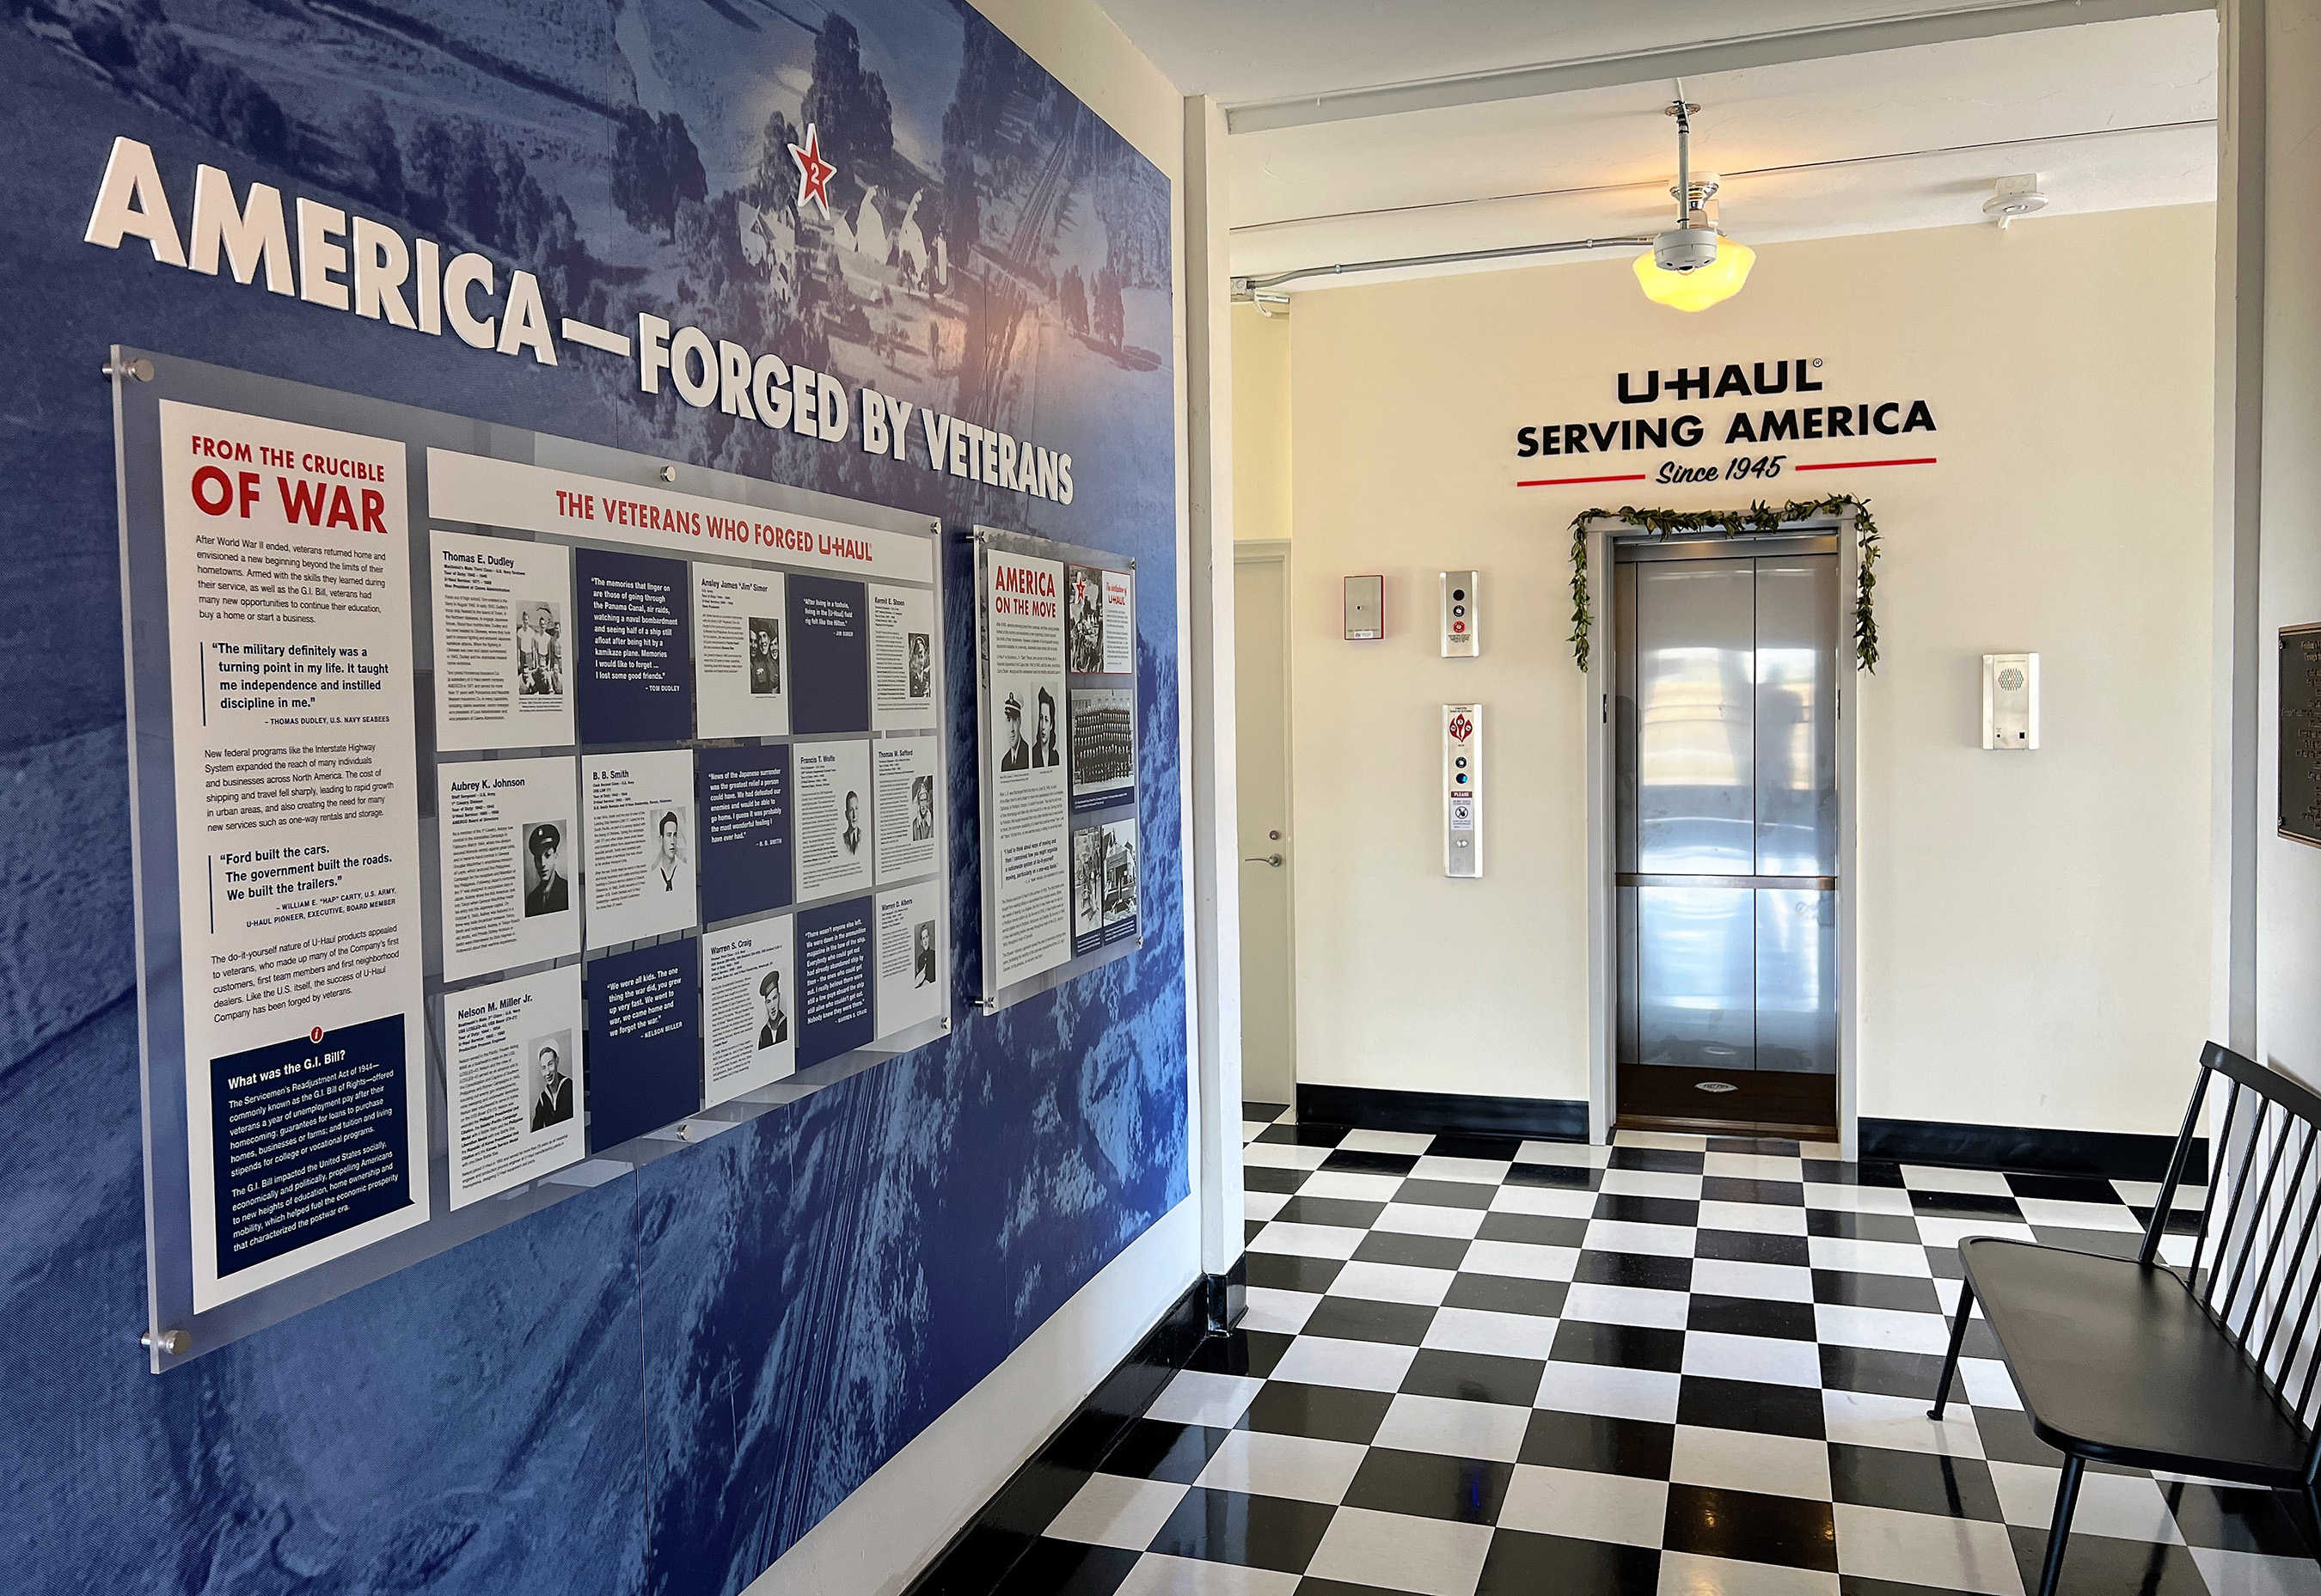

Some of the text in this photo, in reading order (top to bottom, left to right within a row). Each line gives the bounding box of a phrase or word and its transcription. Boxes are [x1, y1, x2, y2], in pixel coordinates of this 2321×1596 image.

[810, 162, 820, 186] 2
[1516, 400, 1937, 457] SERVING AMERICA
[192, 435, 385, 483] FROM THE CRUCIBLE
[862, 387, 913, 462] BY
[921, 407, 1074, 505] VETERANS
[1656, 456, 1786, 484] Since 1945
[191, 465, 389, 535] OF WAR
[555, 490, 594, 521] THE
[602, 498, 701, 536] VETERANS
[706, 515, 750, 543] WHO
[754, 523, 813, 553] FORGED
[195, 535, 386, 561] After World War II ended, veterans returned home and
[995, 565, 1056, 598] AMERICA
[1013, 598, 1029, 616] THE
[1032, 600, 1056, 619] MOVE
[243, 643, 285, 657] military
[288, 644, 336, 658] definitely
[339, 648, 358, 657] was
[218, 661, 389, 676] turning point in my life. It taught
[219, 679, 381, 693] me independence and instilled
[220, 697, 275, 711] discipline
[278, 696, 288, 708] in
[205, 743, 377, 758] New federal programs like the Interstate Highway
[254, 848, 280, 861] built
[283, 847, 301, 859] the
[303, 846, 330, 856] cars.
[225, 853, 392, 883] The government built the roads.
[226, 889, 245, 902] We
[248, 884, 274, 898] built
[276, 883, 294, 894] the
[281, 900, 310, 910] WILLIAM
[340, 892, 363, 902] CARTY,
[364, 890, 377, 899] U.S.
[377, 887, 395, 896] ARMY,
[246, 898, 396, 928] U-HAUL PIONEER, EXECUTIVE, BOARD MEMBER
[227, 1049, 346, 1090] What was the G.I. Bill?
[228, 1099, 243, 1109] The
[291, 1073, 337, 1092] Readjustment
[337, 1069, 350, 1079] Act
[350, 1067, 357, 1076] of
